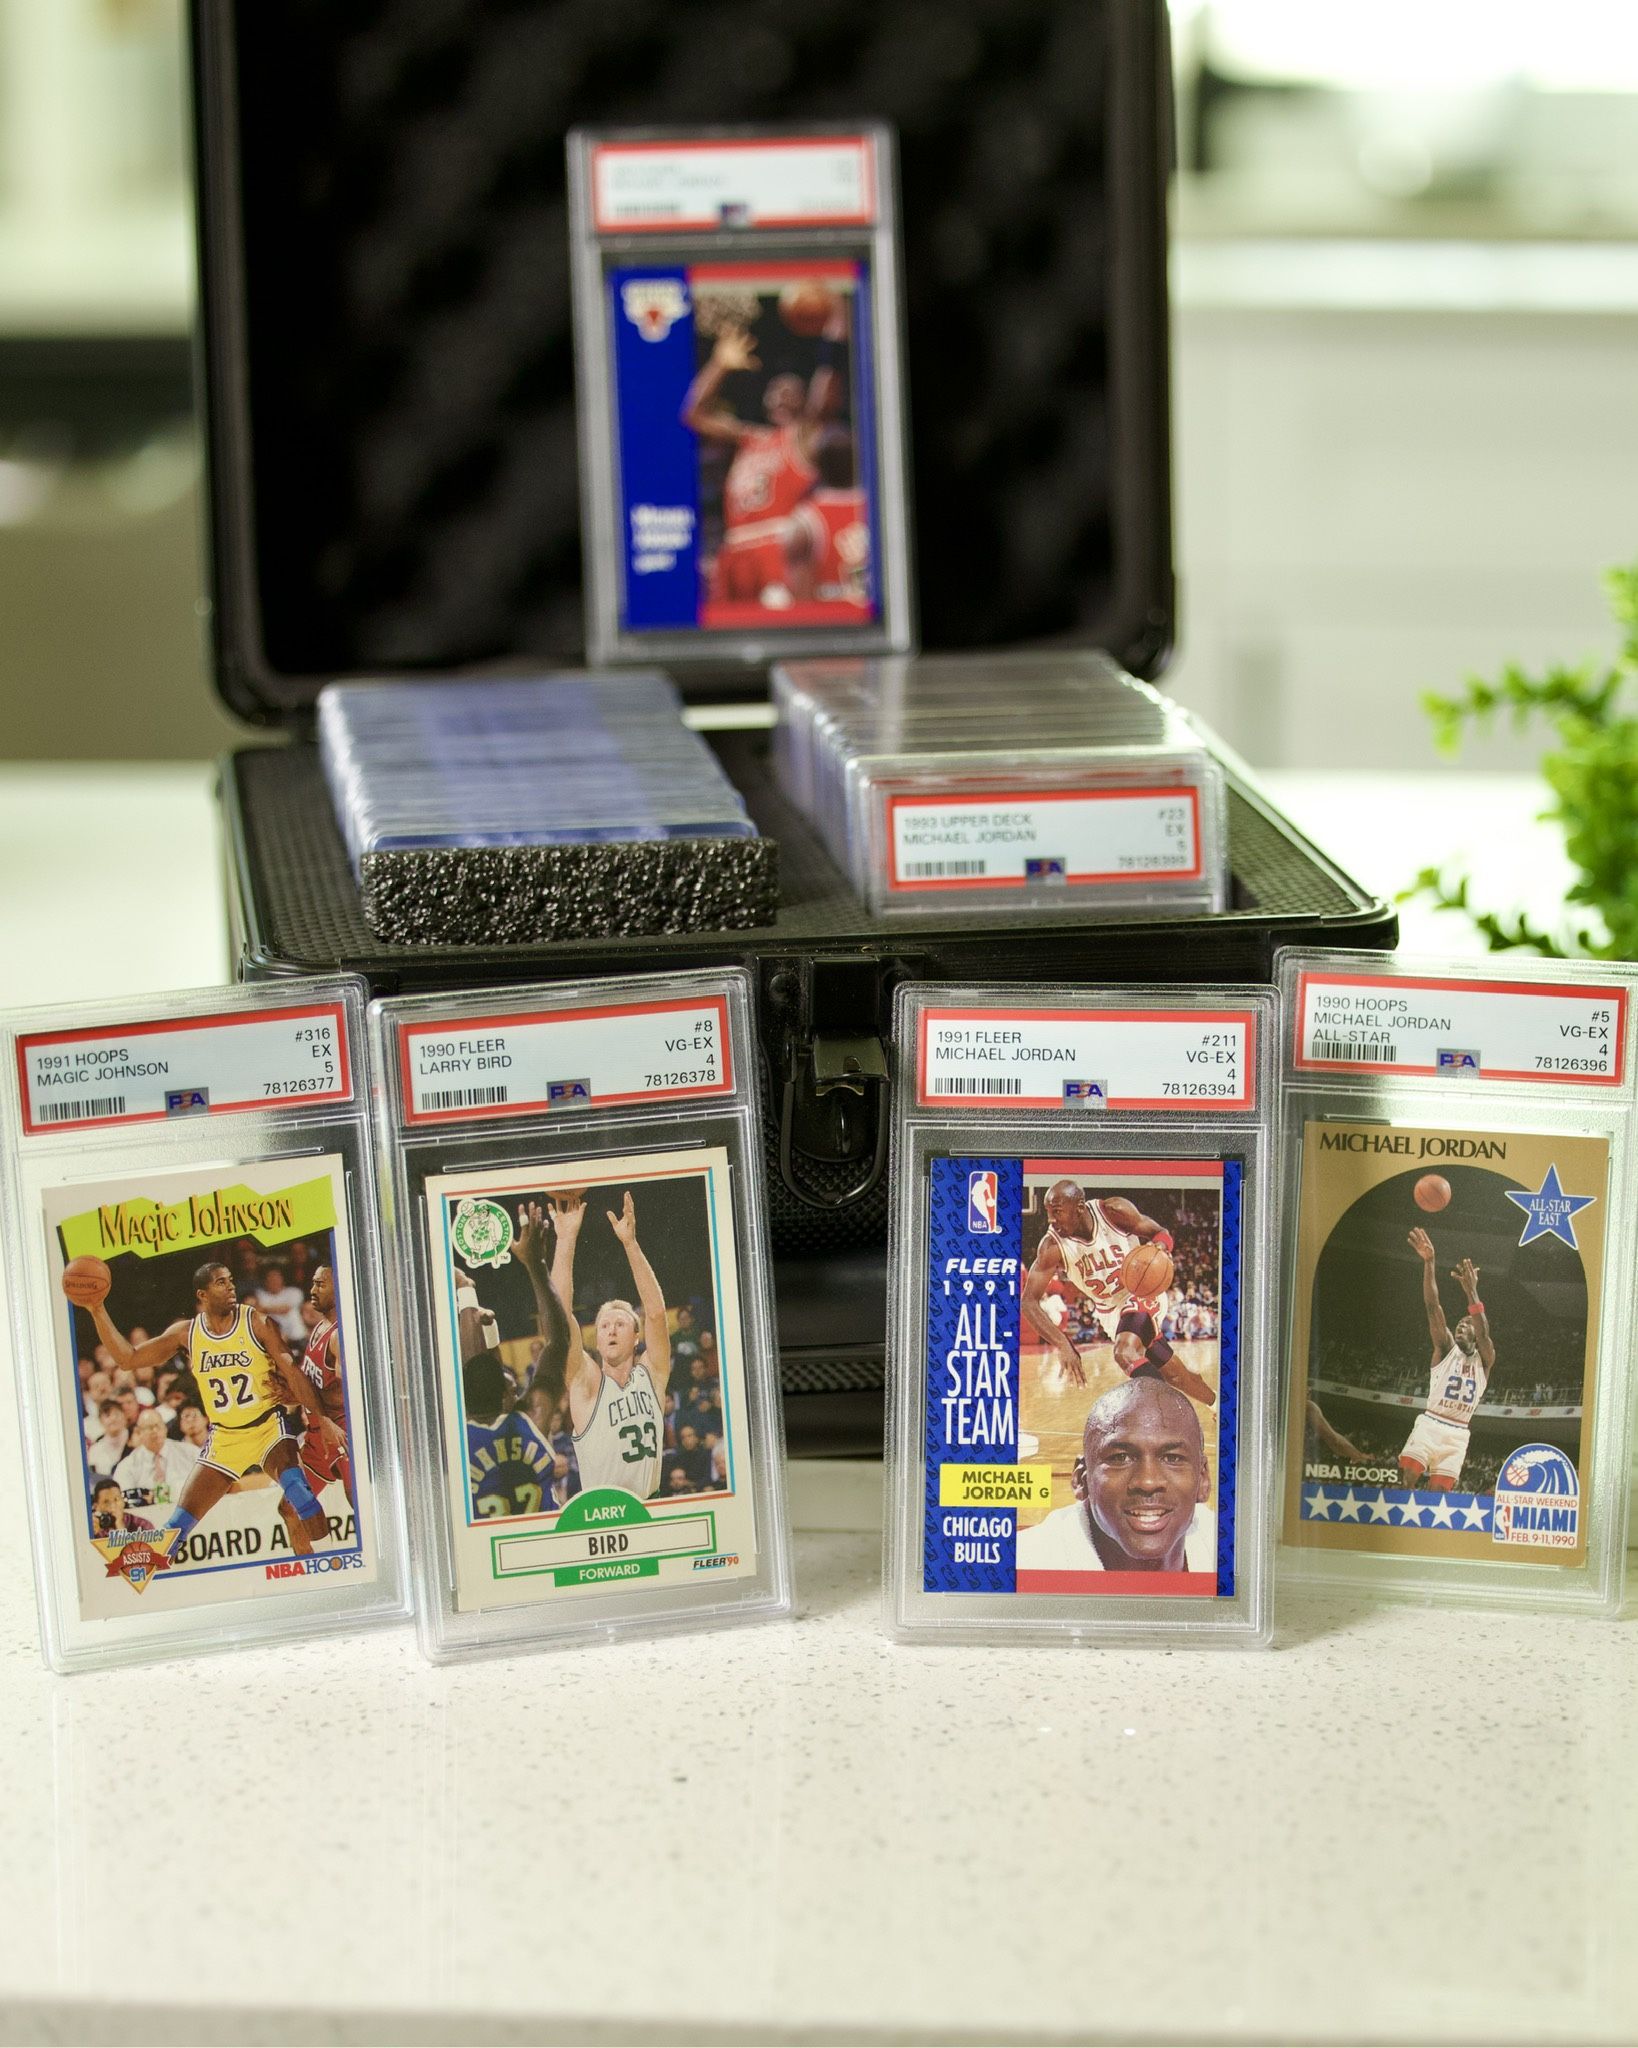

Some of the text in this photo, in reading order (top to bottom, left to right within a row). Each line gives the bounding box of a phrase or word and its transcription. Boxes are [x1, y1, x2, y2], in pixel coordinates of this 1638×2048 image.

[941, 814, 990, 828] UPPER
[992, 813, 1032, 826] DECK
[904, 829, 1037, 845] MICHAEL JORDAN
[1316, 996, 1408, 1012] 1990 HOOPS
[1313, 1012, 1451, 1031] MICHAEL JORDAN
[1591, 1010, 1610, 1023] #5
[694, 1020, 713, 1033] #8
[1560, 1025, 1608, 1039] VG-EX
[295, 1028, 331, 1043] #316
[937, 1031, 1022, 1044] 1991 FLEER
[1201, 1035, 1237, 1047] #211
[1313, 1030, 1391, 1044] ALL-STAR
[311, 1044, 332, 1058] EX
[420, 1038, 506, 1058] 1990 FLEER
[665, 1037, 713, 1052] VG-EX
[1599, 1044, 1608, 1056] 4
[37, 1049, 129, 1070] 1991 HOOPS
[706, 1054, 715, 1066] 4
[935, 1048, 1076, 1062] MICHAEL JORDAN
[1186, 1051, 1236, 1064] VG-EX
[1440, 1053, 1477, 1069] PSA
[325, 1061, 333, 1073] 5
[420, 1055, 512, 1075] LARRY BIRD
[1534, 1056, 1608, 1072] 78126396
[37, 1062, 169, 1087] MAGIC JOHNSON
[645, 1069, 716, 1087] 78126378
[1227, 1068, 1236, 1080] 4
[263, 1078, 335, 1096] 78126377
[550, 1083, 588, 1100] PSA
[1066, 1083, 1103, 1098] PSA
[1162, 1083, 1236, 1096] 78126394
[168, 1091, 206, 1111] PSA
[1319, 1132, 1506, 1160] MICHAEL JORDAN
[1529, 1199, 1571, 1213] ALL-STAR
[972, 1220, 987, 1229] NBA
[1539, 1212, 1561, 1226] EAST
[945, 1258, 1017, 1274] FLEER
[954, 1304, 1012, 1350] ALL-
[200, 1350, 252, 1373] LAKERS
[946, 1351, 1010, 1397] STAR
[208, 1373, 254, 1409] 32
[1444, 1375, 1476, 1403] 23
[941, 1398, 1014, 1445] TEAM
[619, 1422, 657, 1463] 33
[962, 1471, 1033, 1484] MICHAEL
[1306, 1464, 1398, 1483] NBA HOOPS
[963, 1486, 1049, 1500] JORDAN G
[1536, 1497, 1577, 1508] WEEKEND
[584, 1505, 626, 1522] LARRY
[1512, 1506, 1576, 1532] MIAMI
[943, 1516, 1012, 1537] CHICAGO
[107, 1527, 165, 1548] Milestones
[174, 1526, 261, 1564] BOARD
[589, 1534, 628, 1556] BIRD
[123, 1552, 151, 1565] ASSISTS
[954, 1543, 1000, 1563] BULLS
[579, 1563, 640, 1580] FORWARD
